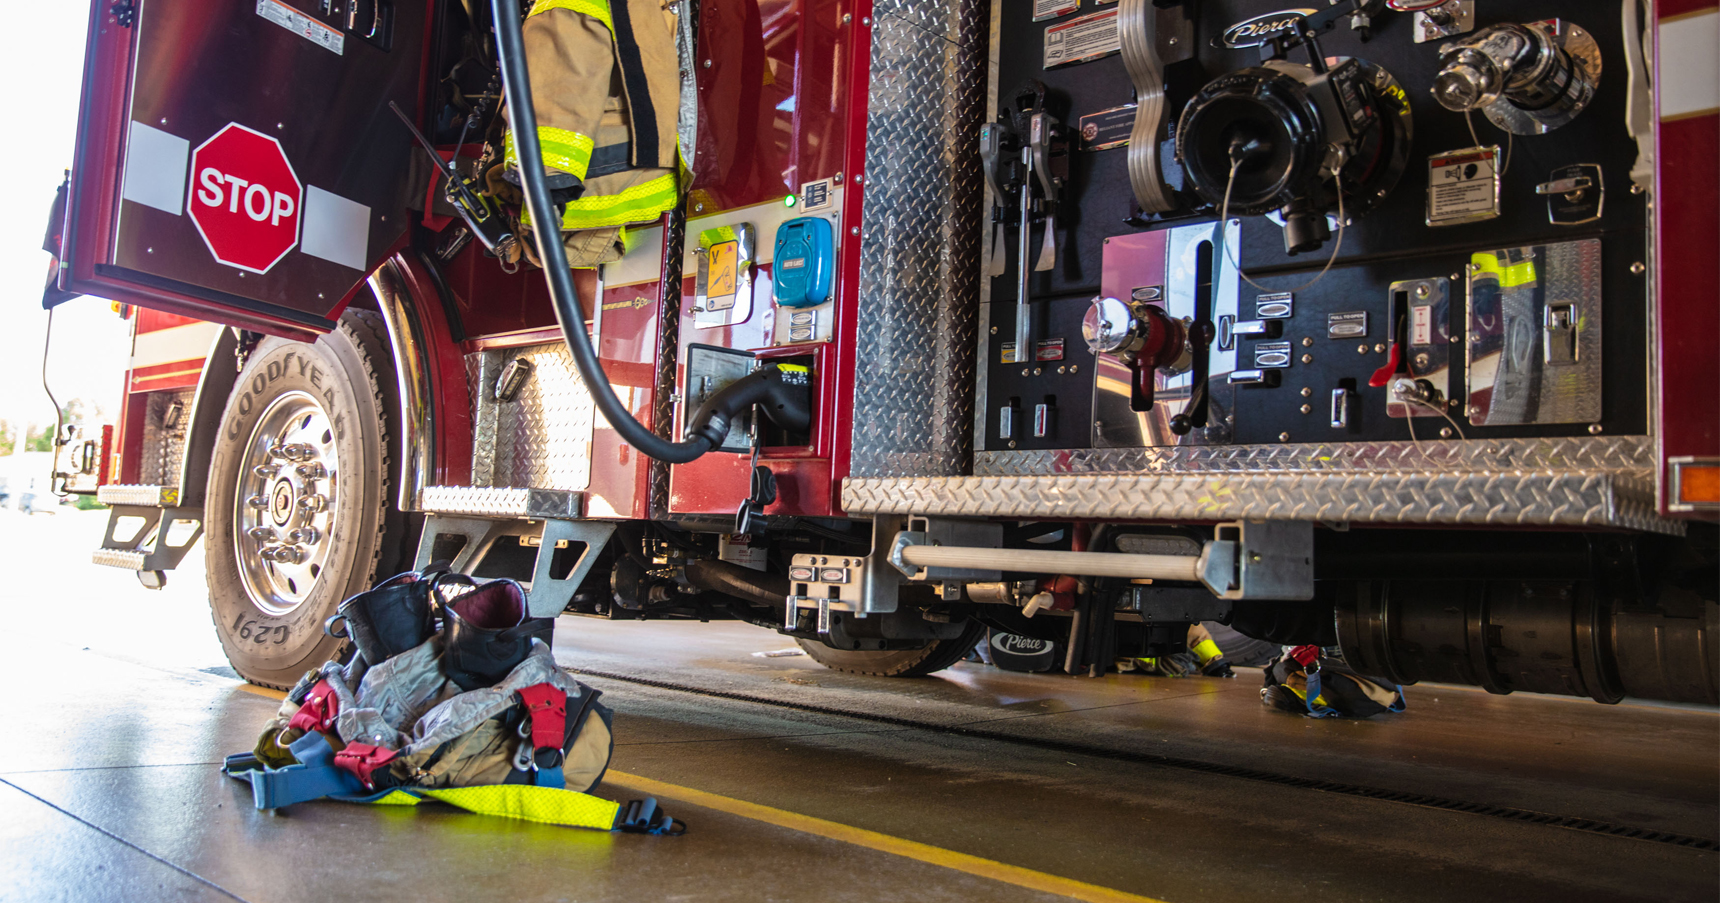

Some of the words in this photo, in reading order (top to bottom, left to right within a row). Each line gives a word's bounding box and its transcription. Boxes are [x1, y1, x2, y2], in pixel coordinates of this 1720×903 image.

[197, 167, 295, 226] STOP
[228, 352, 346, 441] GOODYEAR
[232, 611, 290, 645] G291
[1005, 633, 1042, 650] Pierce
